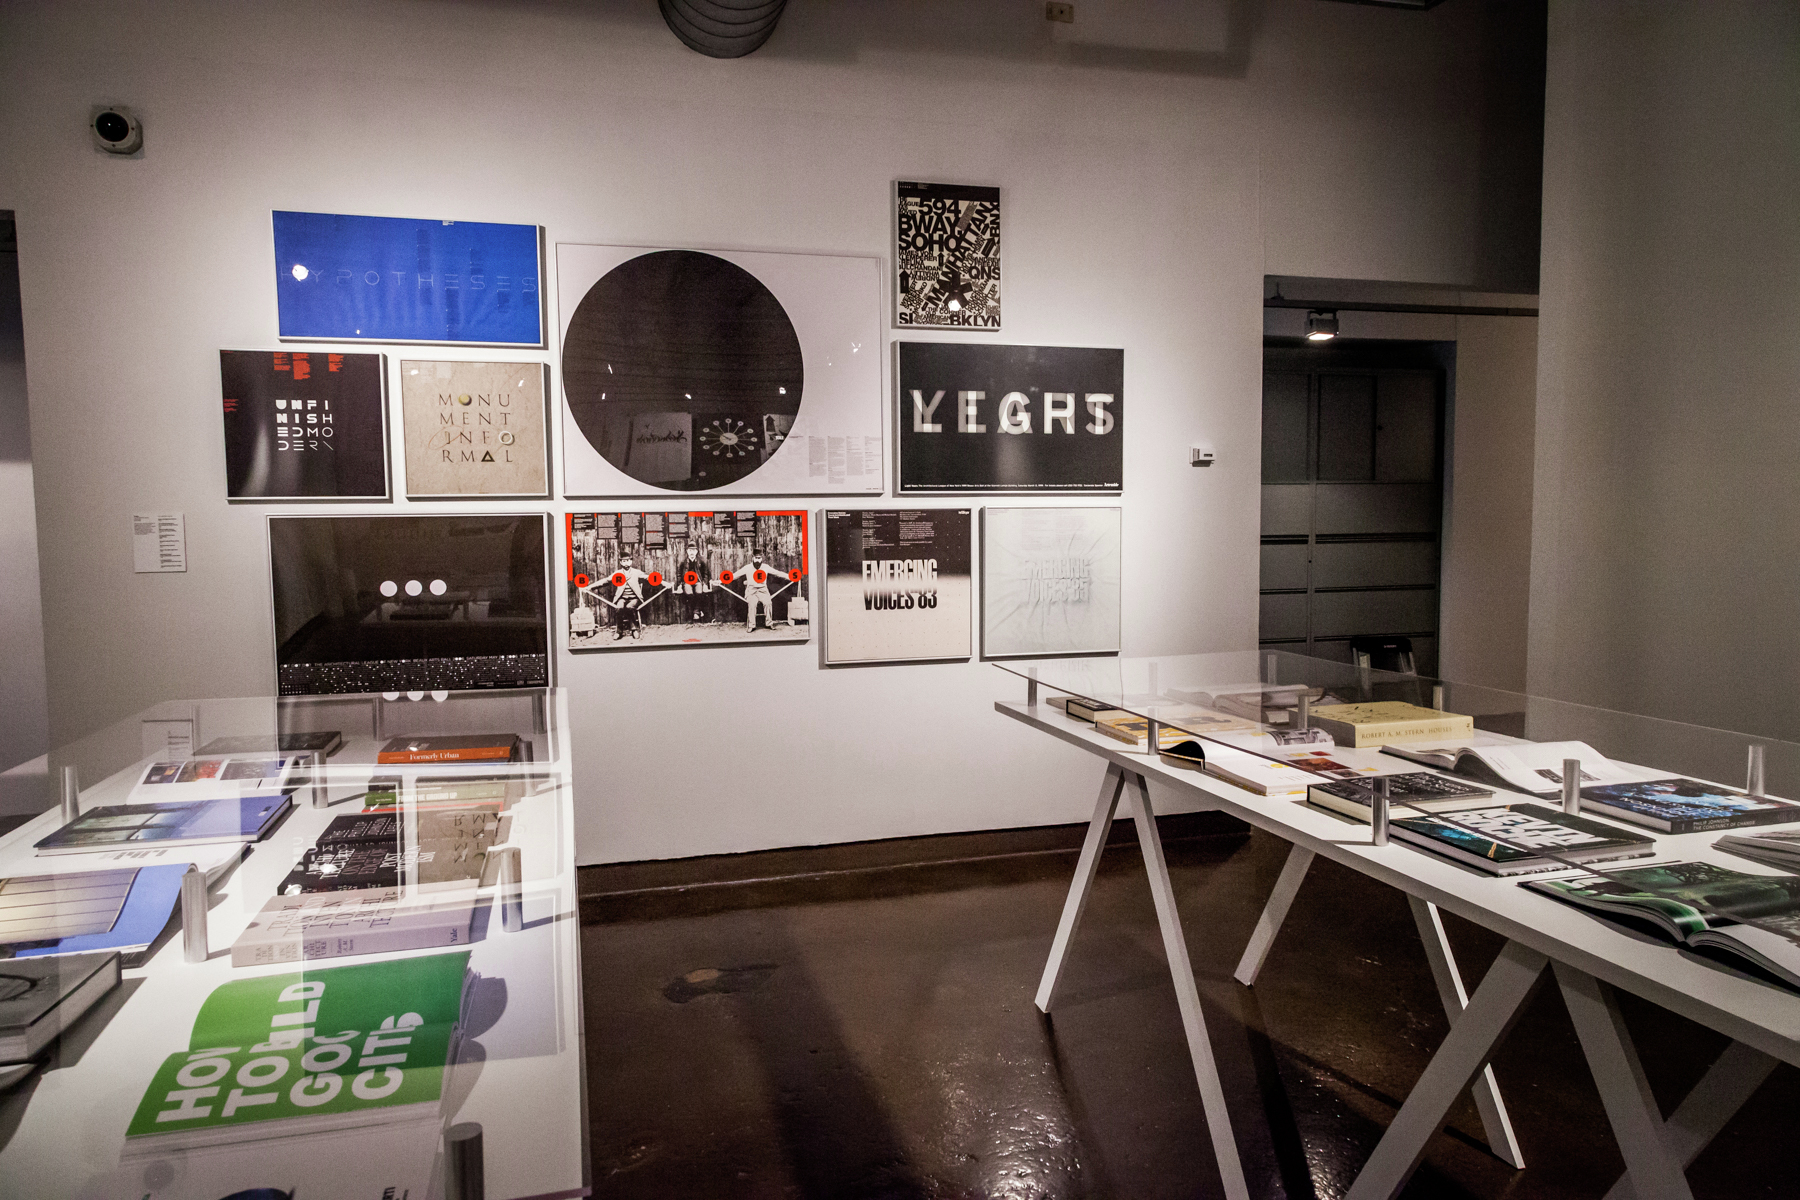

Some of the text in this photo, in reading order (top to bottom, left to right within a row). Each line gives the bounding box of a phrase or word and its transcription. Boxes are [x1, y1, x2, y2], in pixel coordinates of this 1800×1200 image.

[919, 199, 961, 217] 594
[899, 214, 960, 234] BWAY
[899, 232, 960, 252] SOHO
[968, 266, 1000, 280] QNS
[950, 314, 1000, 327] BKLYN
[440, 412, 510, 425] MENT
[863, 588, 914, 610] VOICES
[221, 1056, 289, 1118] TO
